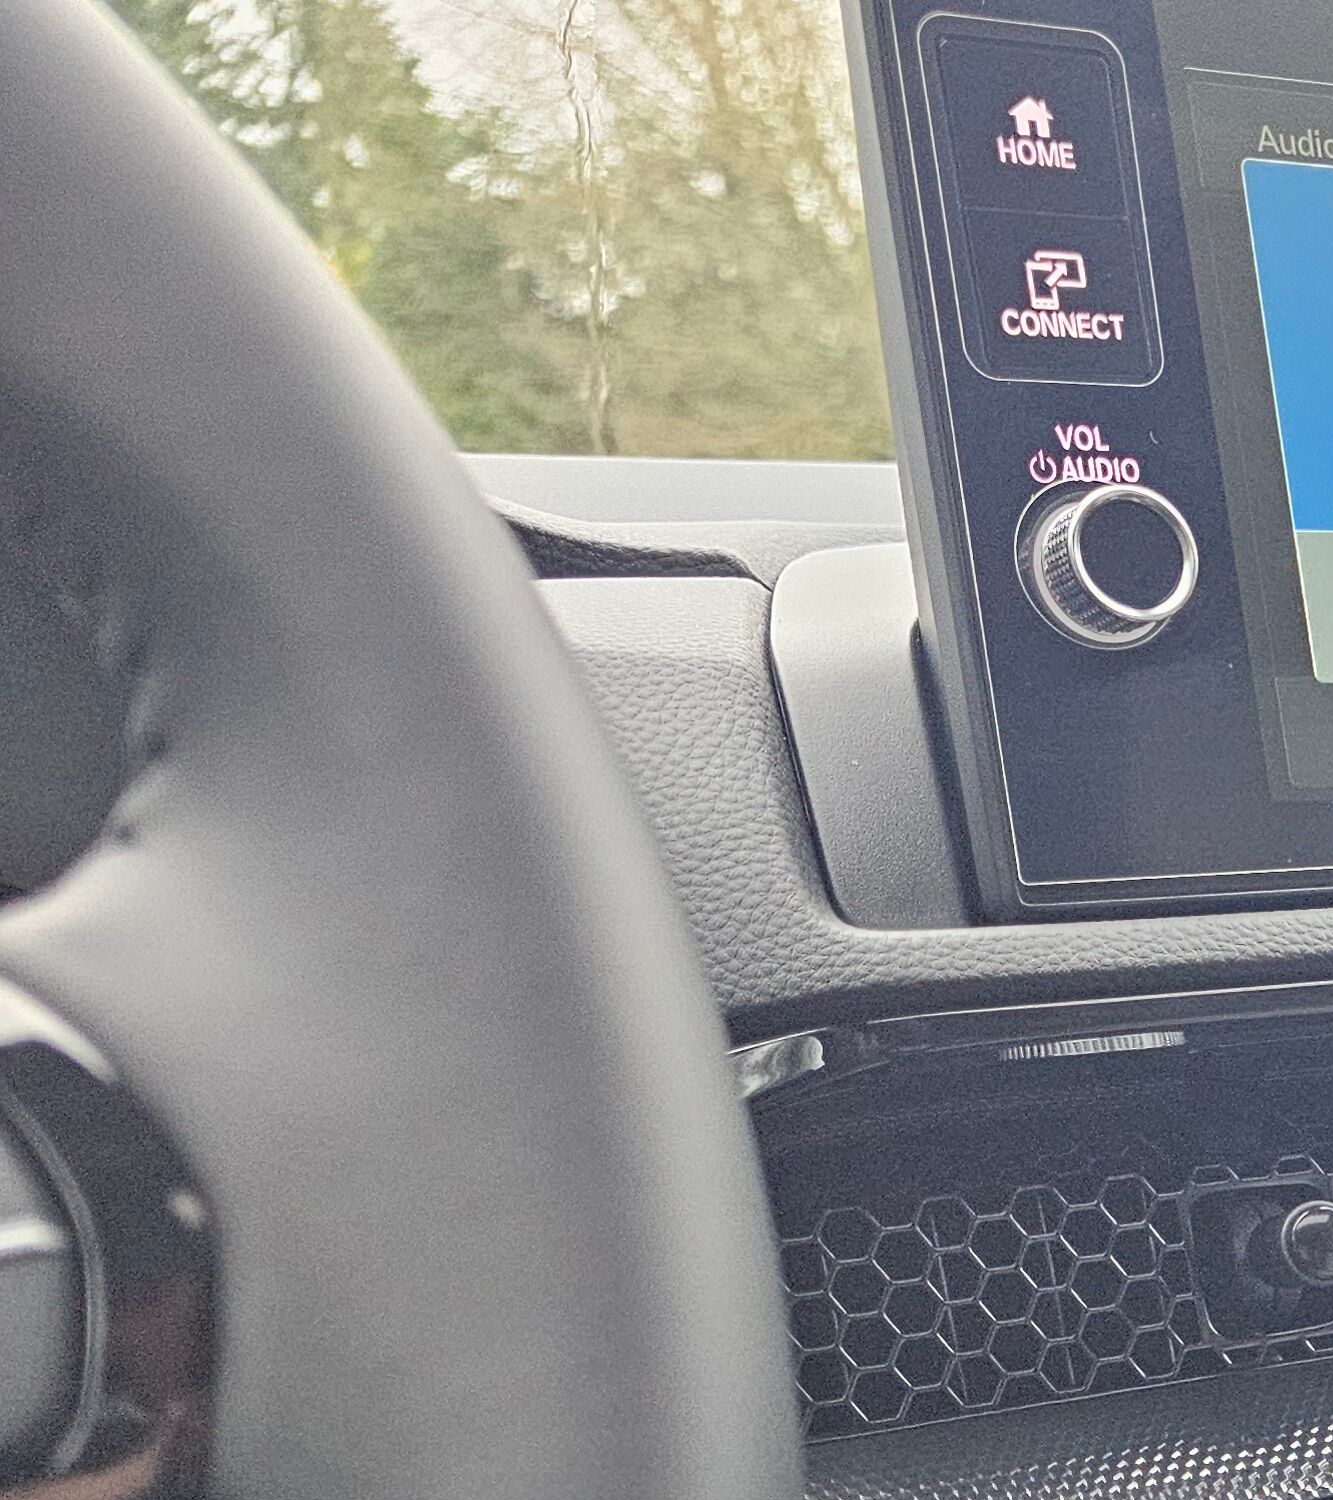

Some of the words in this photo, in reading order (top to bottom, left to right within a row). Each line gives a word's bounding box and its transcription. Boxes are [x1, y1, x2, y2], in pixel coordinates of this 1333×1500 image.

[997, 136, 1076, 170] HOME
[1001, 308, 1124, 341] CONNECT
[1054, 423, 1110, 452] VOL
[1062, 455, 1140, 483] AUDIO
